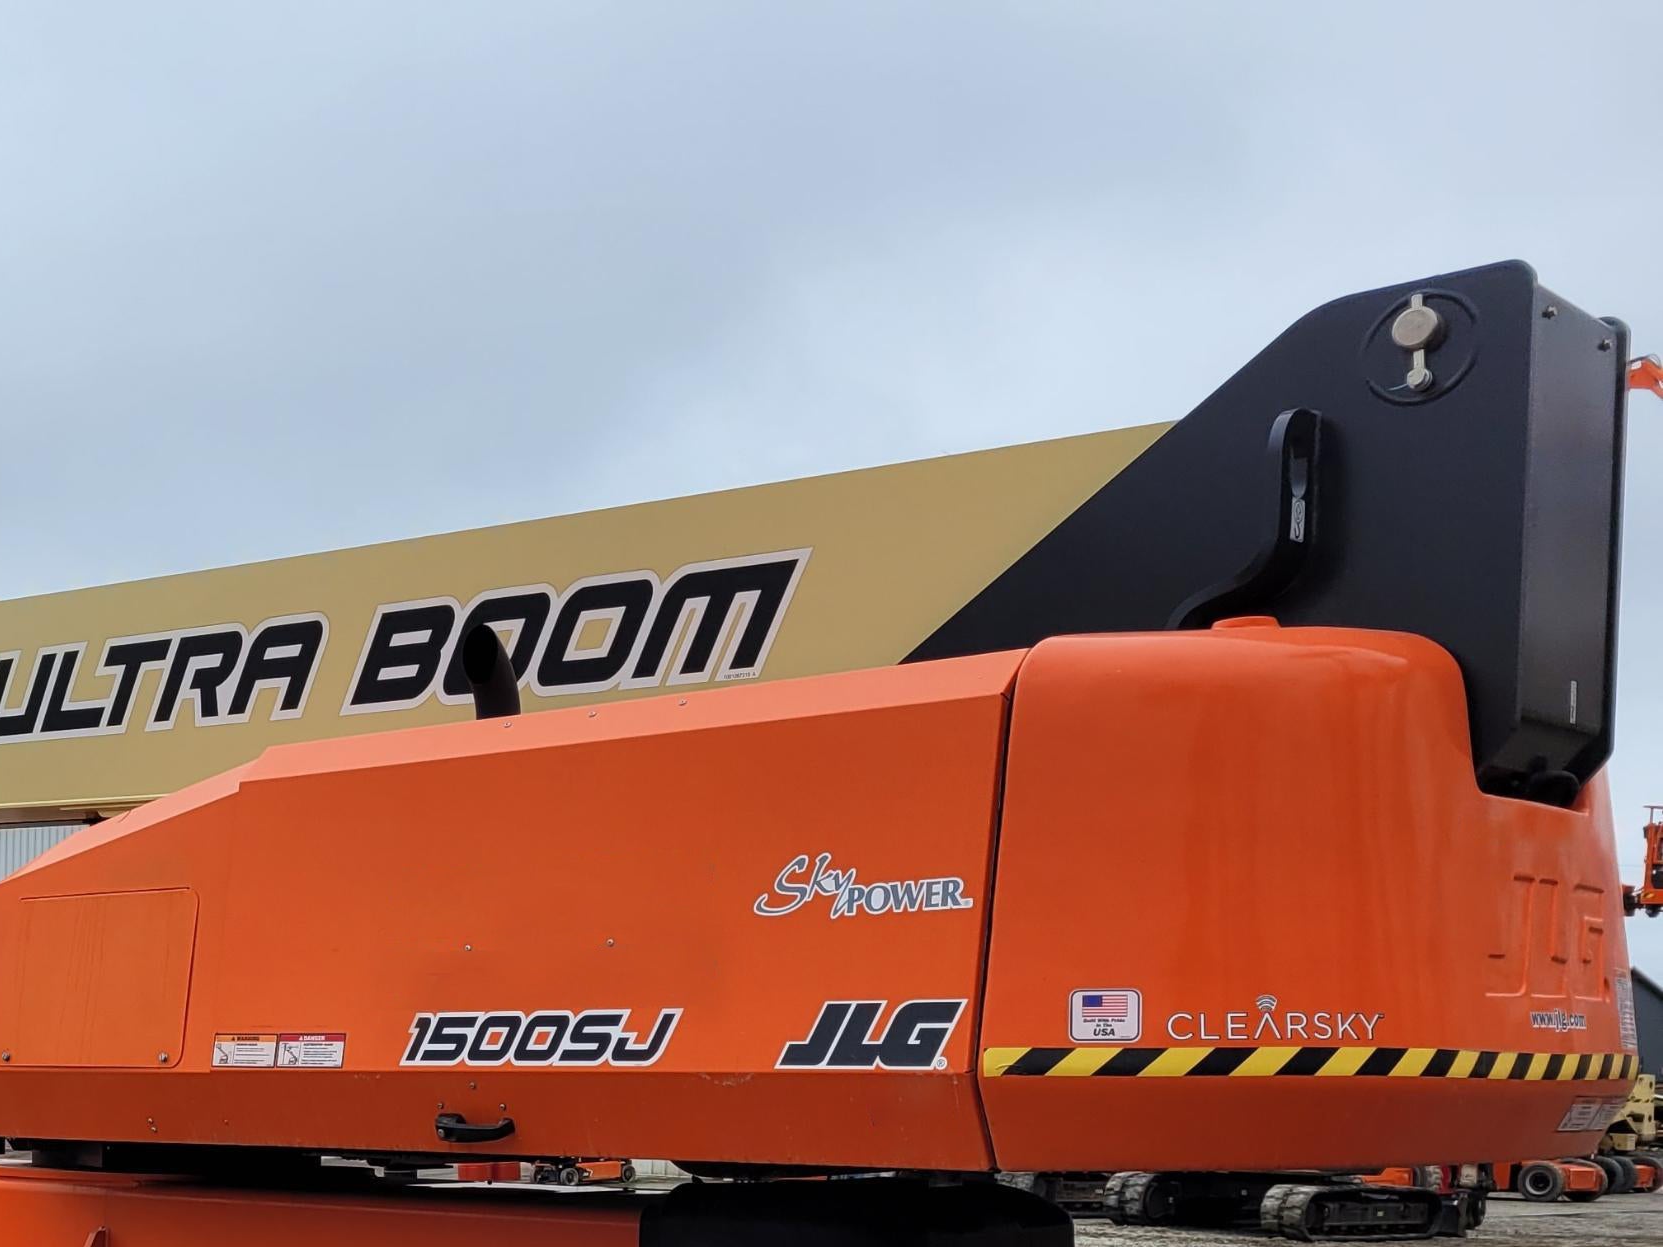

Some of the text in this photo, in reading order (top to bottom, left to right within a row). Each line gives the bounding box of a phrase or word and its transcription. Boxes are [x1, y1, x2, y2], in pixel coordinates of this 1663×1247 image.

[342, 552, 808, 712] BOOM
[402, 1010, 680, 1064] 1500SJ
[776, 1000, 966, 1069] JLG
[1093, 1028, 1115, 1036] USA
[1167, 1010, 1381, 1041] CLEARSKY
[1531, 1009, 1587, 1031] www.jlg.com
